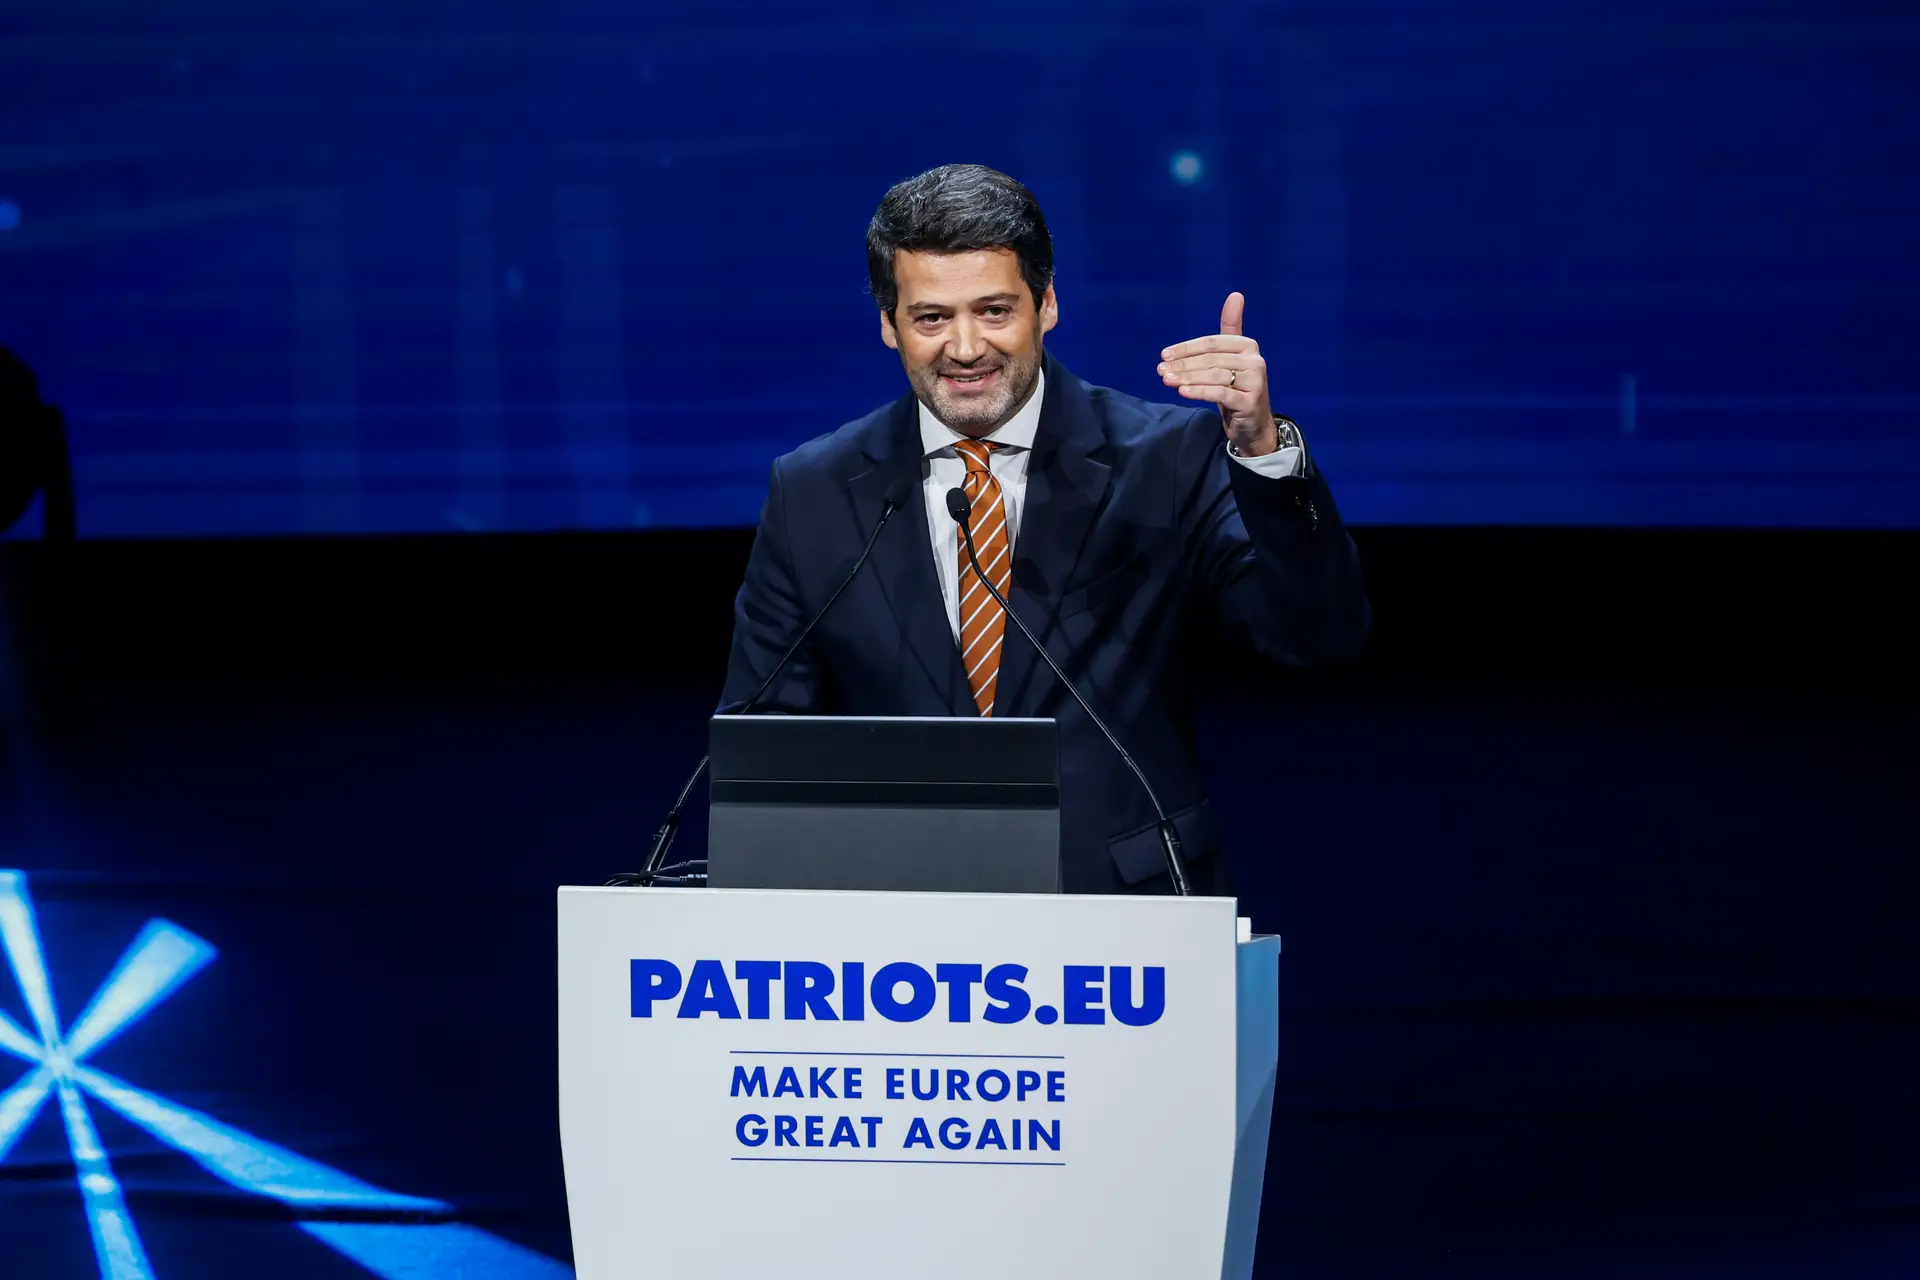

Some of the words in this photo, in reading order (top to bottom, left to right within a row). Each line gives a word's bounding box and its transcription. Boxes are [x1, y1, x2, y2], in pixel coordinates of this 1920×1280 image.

[629, 958, 1166, 1027] PATRIOTS.EU
[730, 1065, 863, 1100] MAKE
[885, 1068, 1066, 1103] EUROPE
[735, 1113, 884, 1149] GREAT
[903, 1117, 1062, 1152] AGAIN
